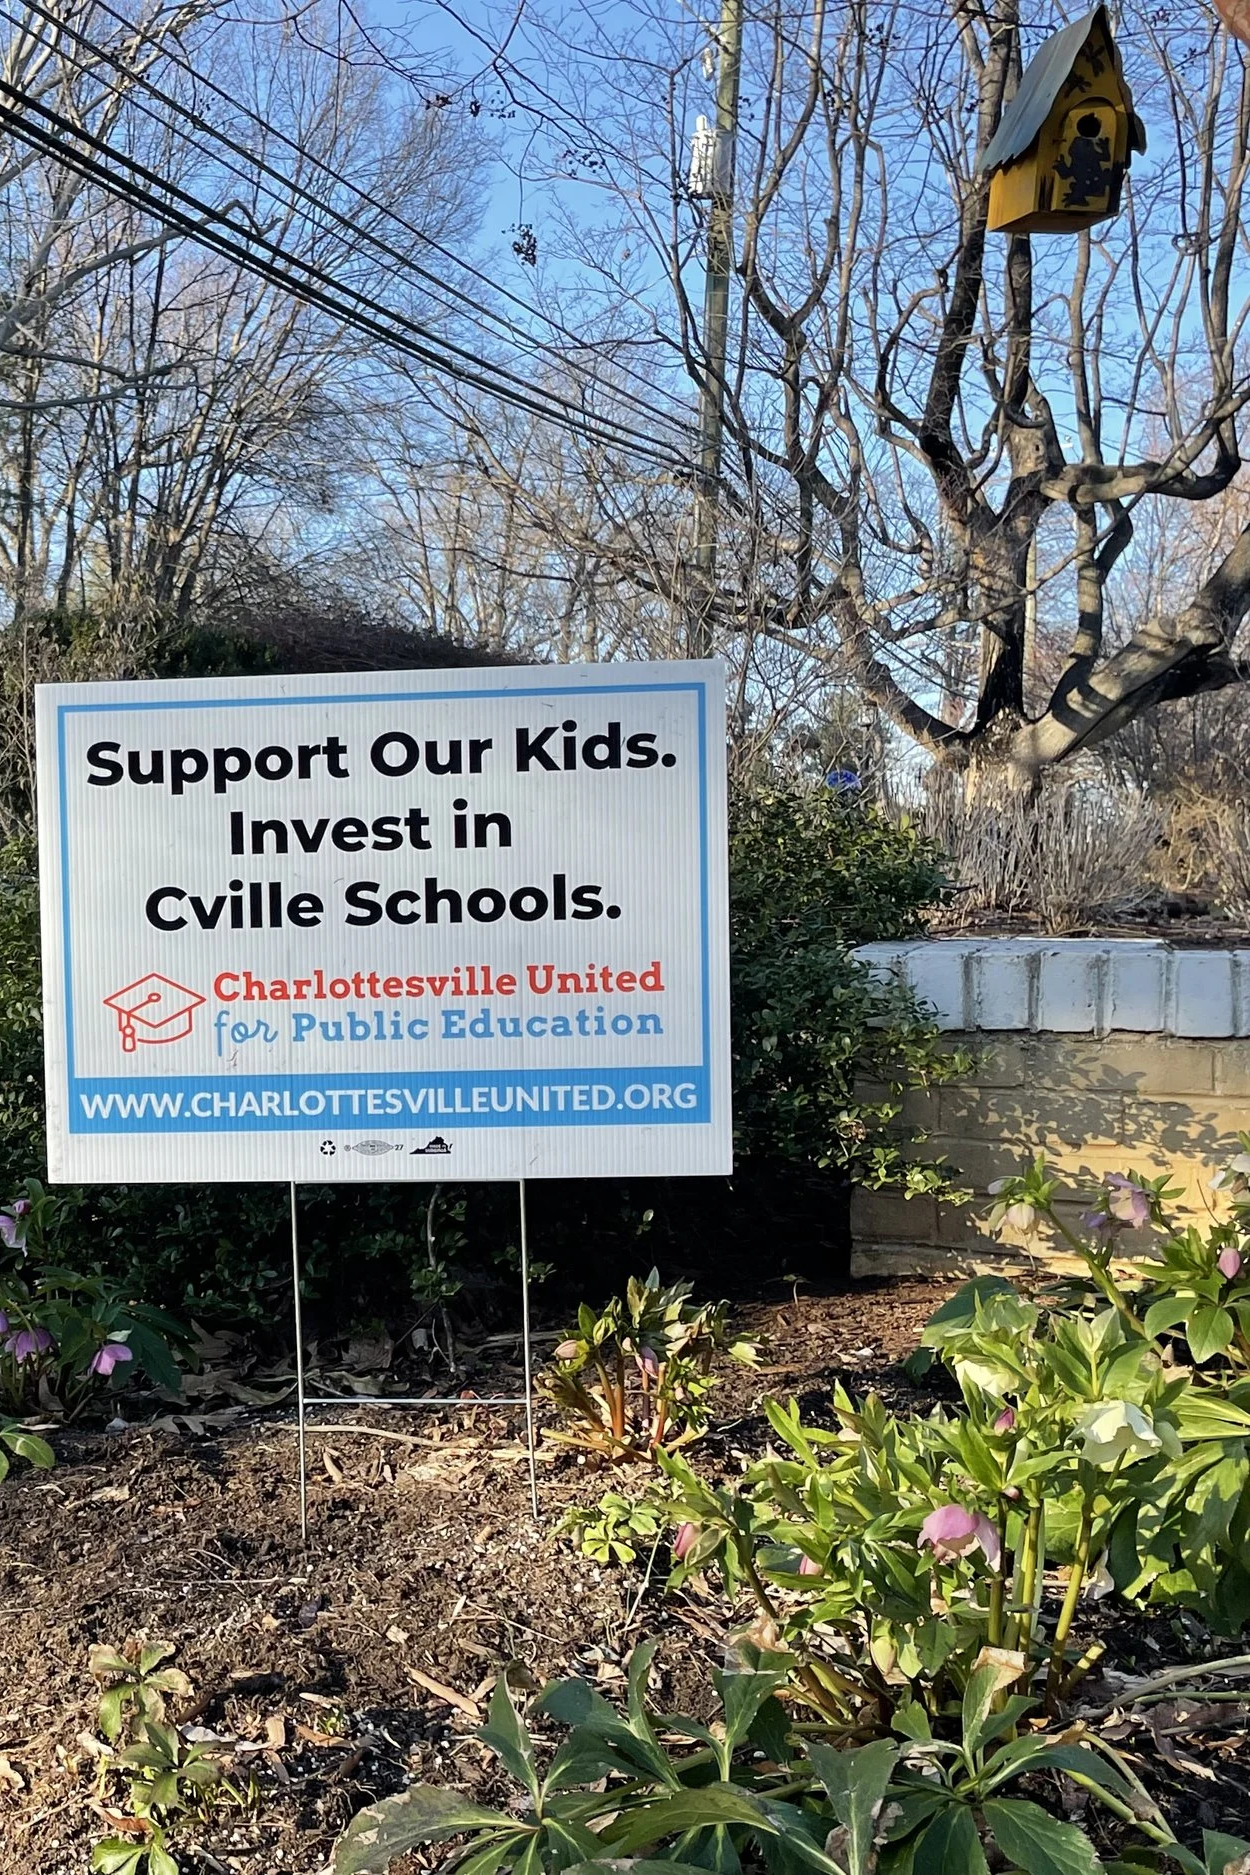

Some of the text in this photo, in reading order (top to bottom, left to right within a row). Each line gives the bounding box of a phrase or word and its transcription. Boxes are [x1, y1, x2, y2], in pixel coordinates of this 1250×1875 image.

[86, 719, 677, 796] Support Our Kids.
[230, 798, 512, 855] Invest in
[145, 873, 622, 932] Cville Schools.
[212, 960, 665, 1003] Charlottesville United
[213, 1003, 667, 1058] for Public Education
[79, 1083, 697, 1119] WWW.CHARLOTTESVILLEUNITED.ORG
